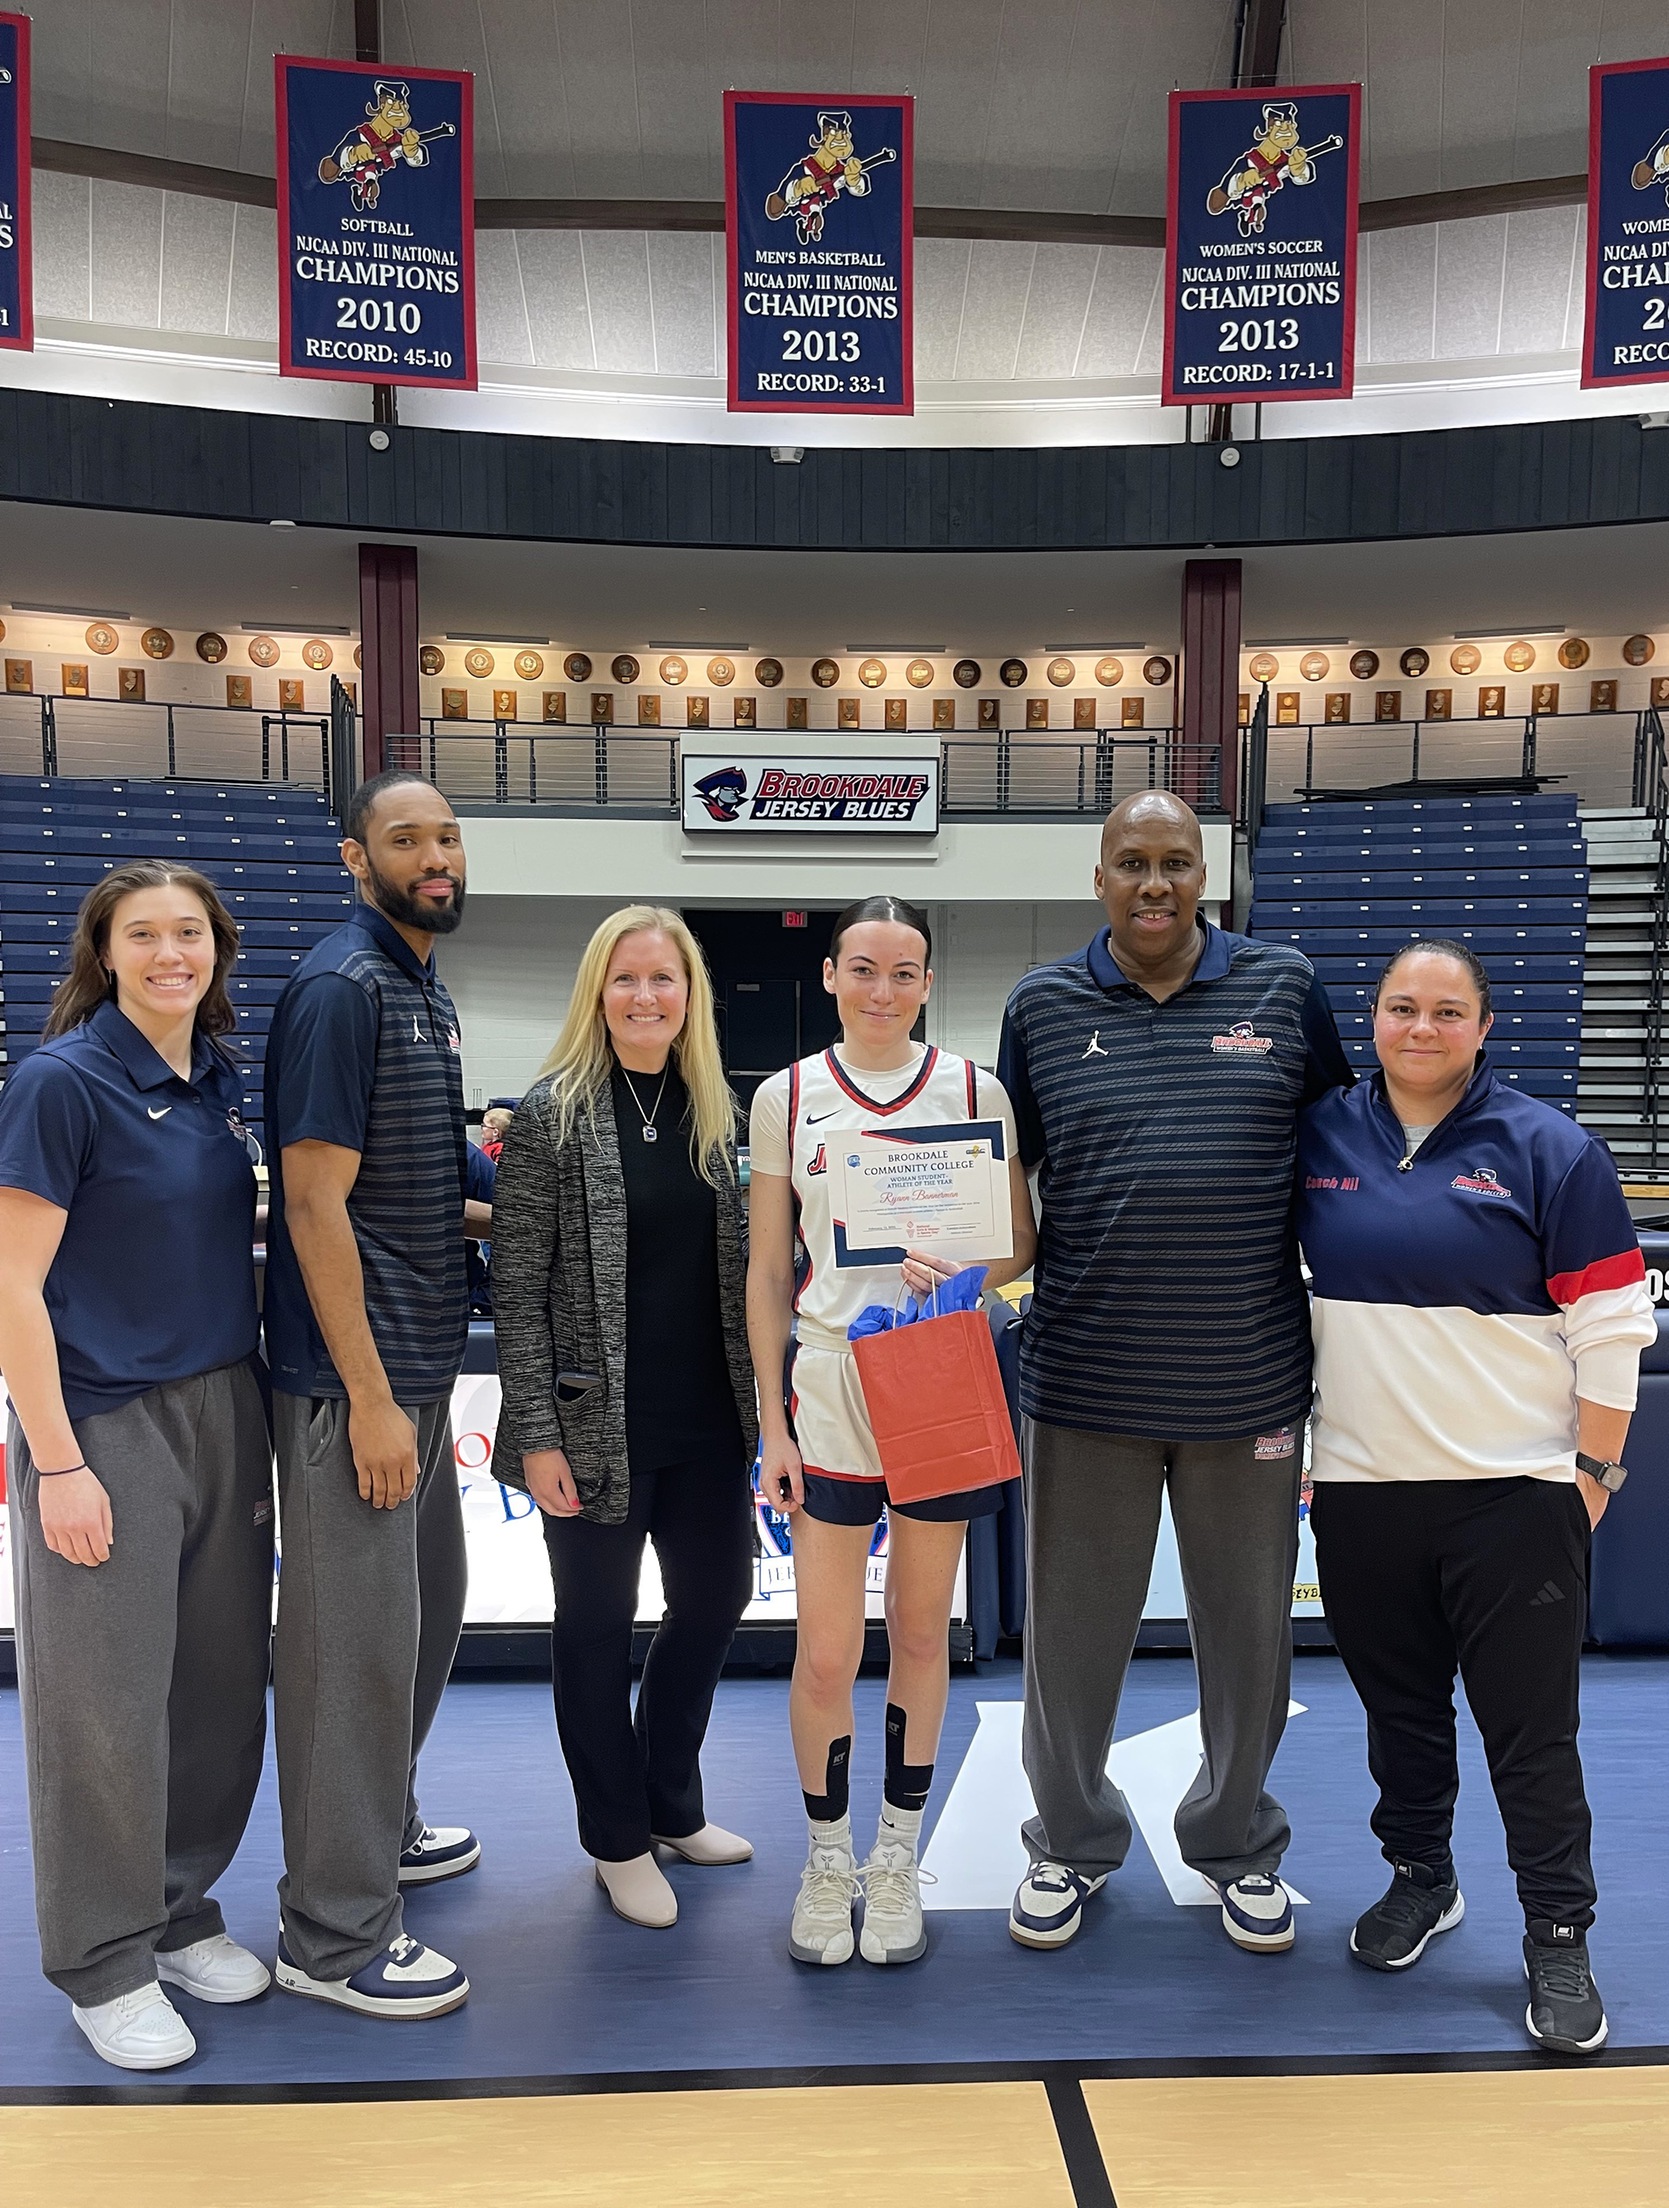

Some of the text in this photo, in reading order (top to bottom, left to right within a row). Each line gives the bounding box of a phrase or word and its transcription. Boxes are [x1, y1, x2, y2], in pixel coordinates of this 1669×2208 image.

[340, 217, 414, 237] SOFTBALL
[296, 235, 459, 267] NJCAA DIV. III NATIONAL
[755, 249, 886, 267] MEN'S BASKETBALL
[1199, 240, 1324, 258] WOMEN'S SOCCER
[1603, 244, 1649, 262] NJCAA
[296, 256, 459, 294] CHAMPIONS
[743, 272, 898, 292] NJCAA DIV. III NATIONAL
[1181, 260, 1341, 283] NJCAA DIV. III NATIONAL
[1602, 262, 1669, 289] CHA
[744, 292, 898, 320] CHAMPIONS
[1181, 281, 1340, 311] CHAMPIONS
[336, 297, 421, 335] 2010
[1642, 298, 1669, 331] 2
[782, 329, 861, 363] 2013
[1218, 318, 1299, 352] 2013
[305, 337, 452, 369] RECORD: 45-10
[757, 372, 886, 393] RECORD: 33-1
[1182, 361, 1334, 384] RECORD: 17-1-1
[757, 770, 928, 799] BROOKDALE
[755, 801, 911, 819] JERSEY BLUES
[786, 911, 804, 926] EXIT
[864, 1160, 975, 1176] COMMUNITY COLLEGE
[888, 1150, 949, 1163] BROOKDALE
[887, 1181, 913, 1189] ATHLETE
[890, 1173, 949, 1183] WOMAN STUDENT-
